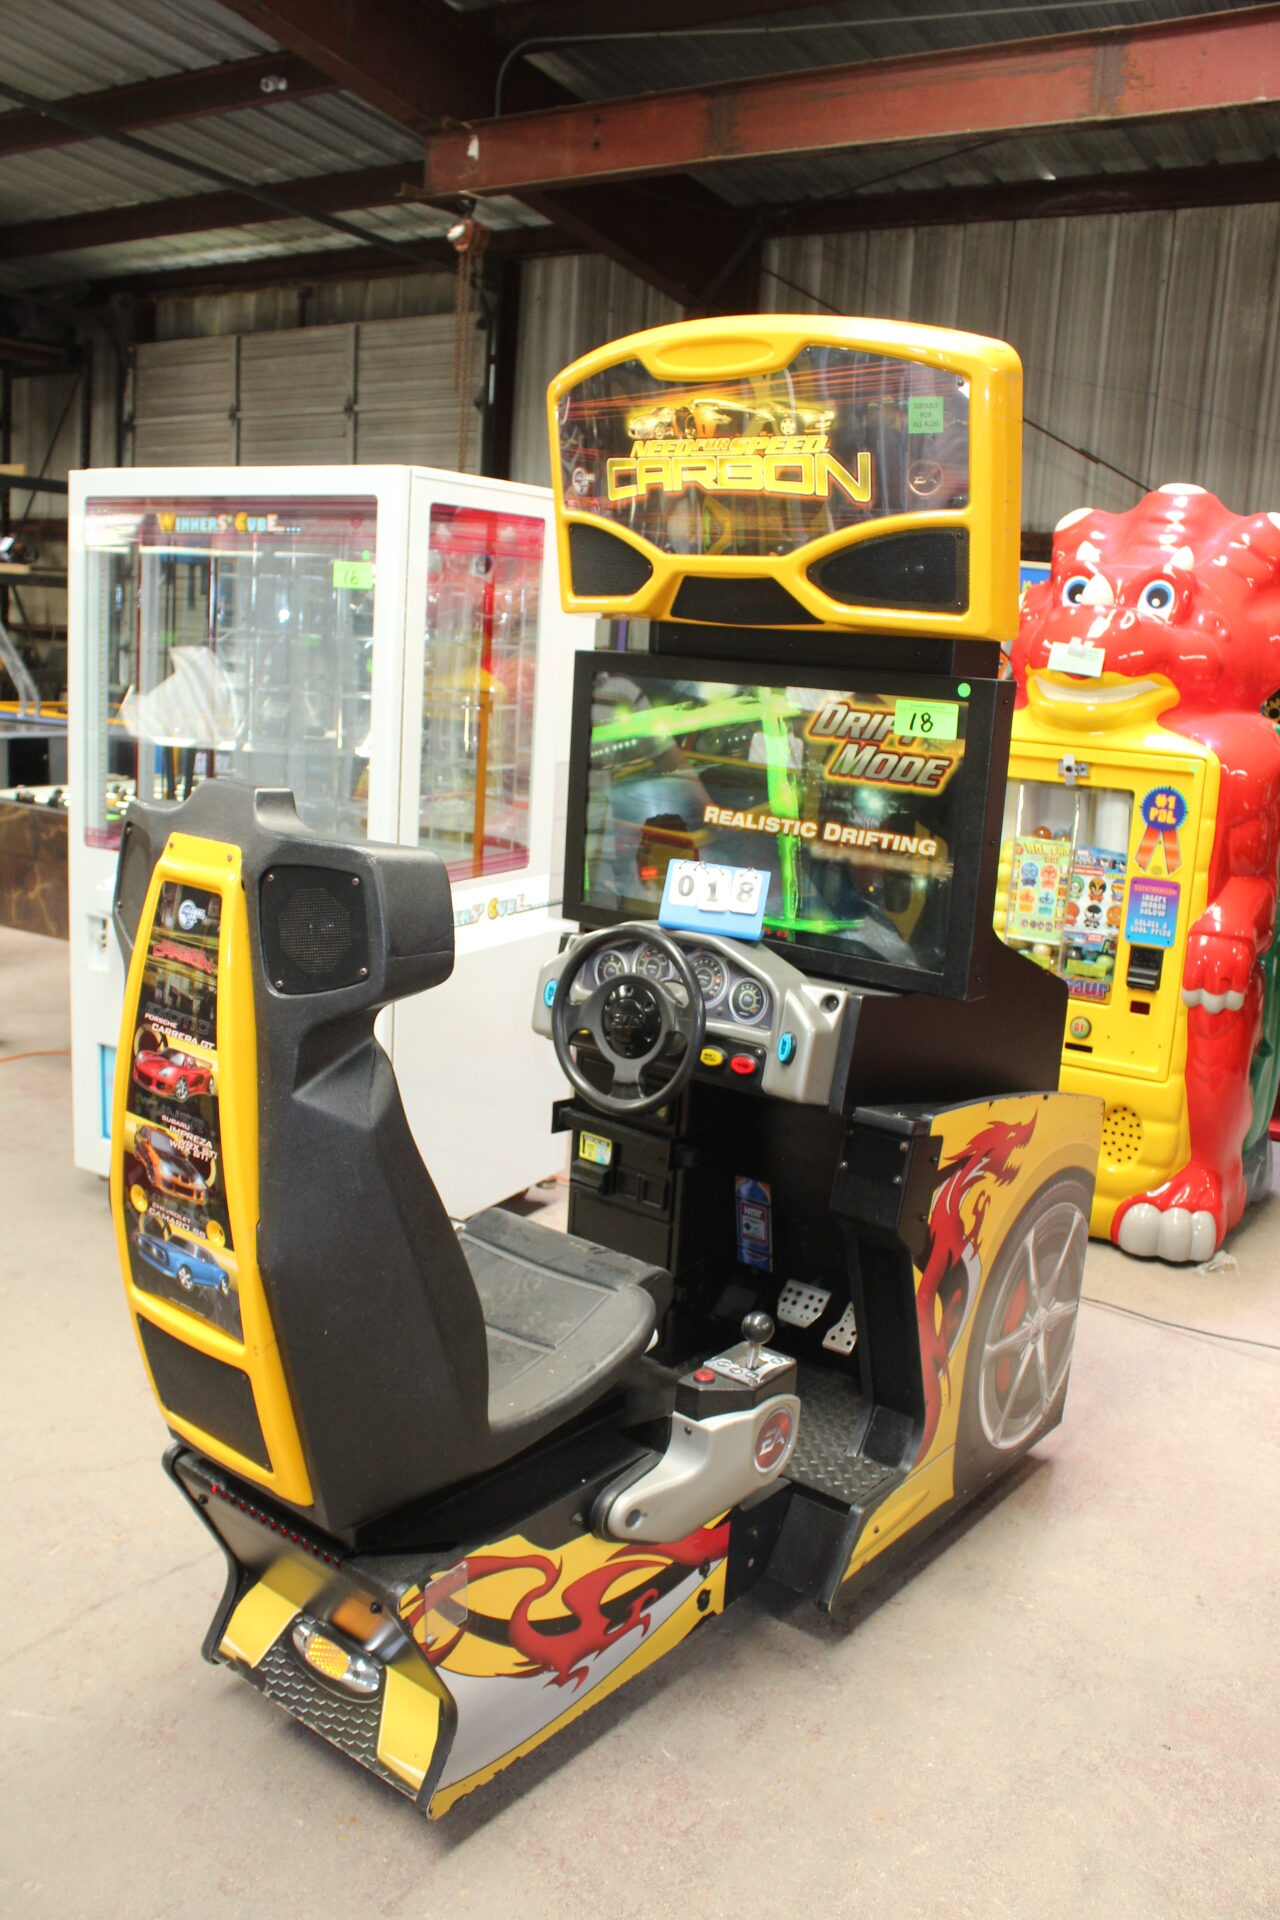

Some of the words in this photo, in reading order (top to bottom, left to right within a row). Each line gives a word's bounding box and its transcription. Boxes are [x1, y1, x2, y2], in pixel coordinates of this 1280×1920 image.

[630, 439, 693, 458] NEED
[693, 438, 731, 452] FOR
[730, 435, 828, 456] SPEED
[607, 452, 872, 503] CARBON
[343, 569, 360, 586] 16
[811, 701, 918, 746] DRIF
[909, 711, 934, 733] 18
[830, 743, 951, 787] MODE
[703, 805, 818, 838] REALISTIC
[823, 822, 937, 857] DRIFTING
[144, 1012, 178, 1030] PORSCHE
[151, 1022, 199, 1046] CARRERA
[200, 1039, 216, 1050] GT
[161, 1114, 191, 1131] SUBARU
[169, 1125, 213, 1149] IMPREZA
[148, 1206, 190, 1232] CAMARO
